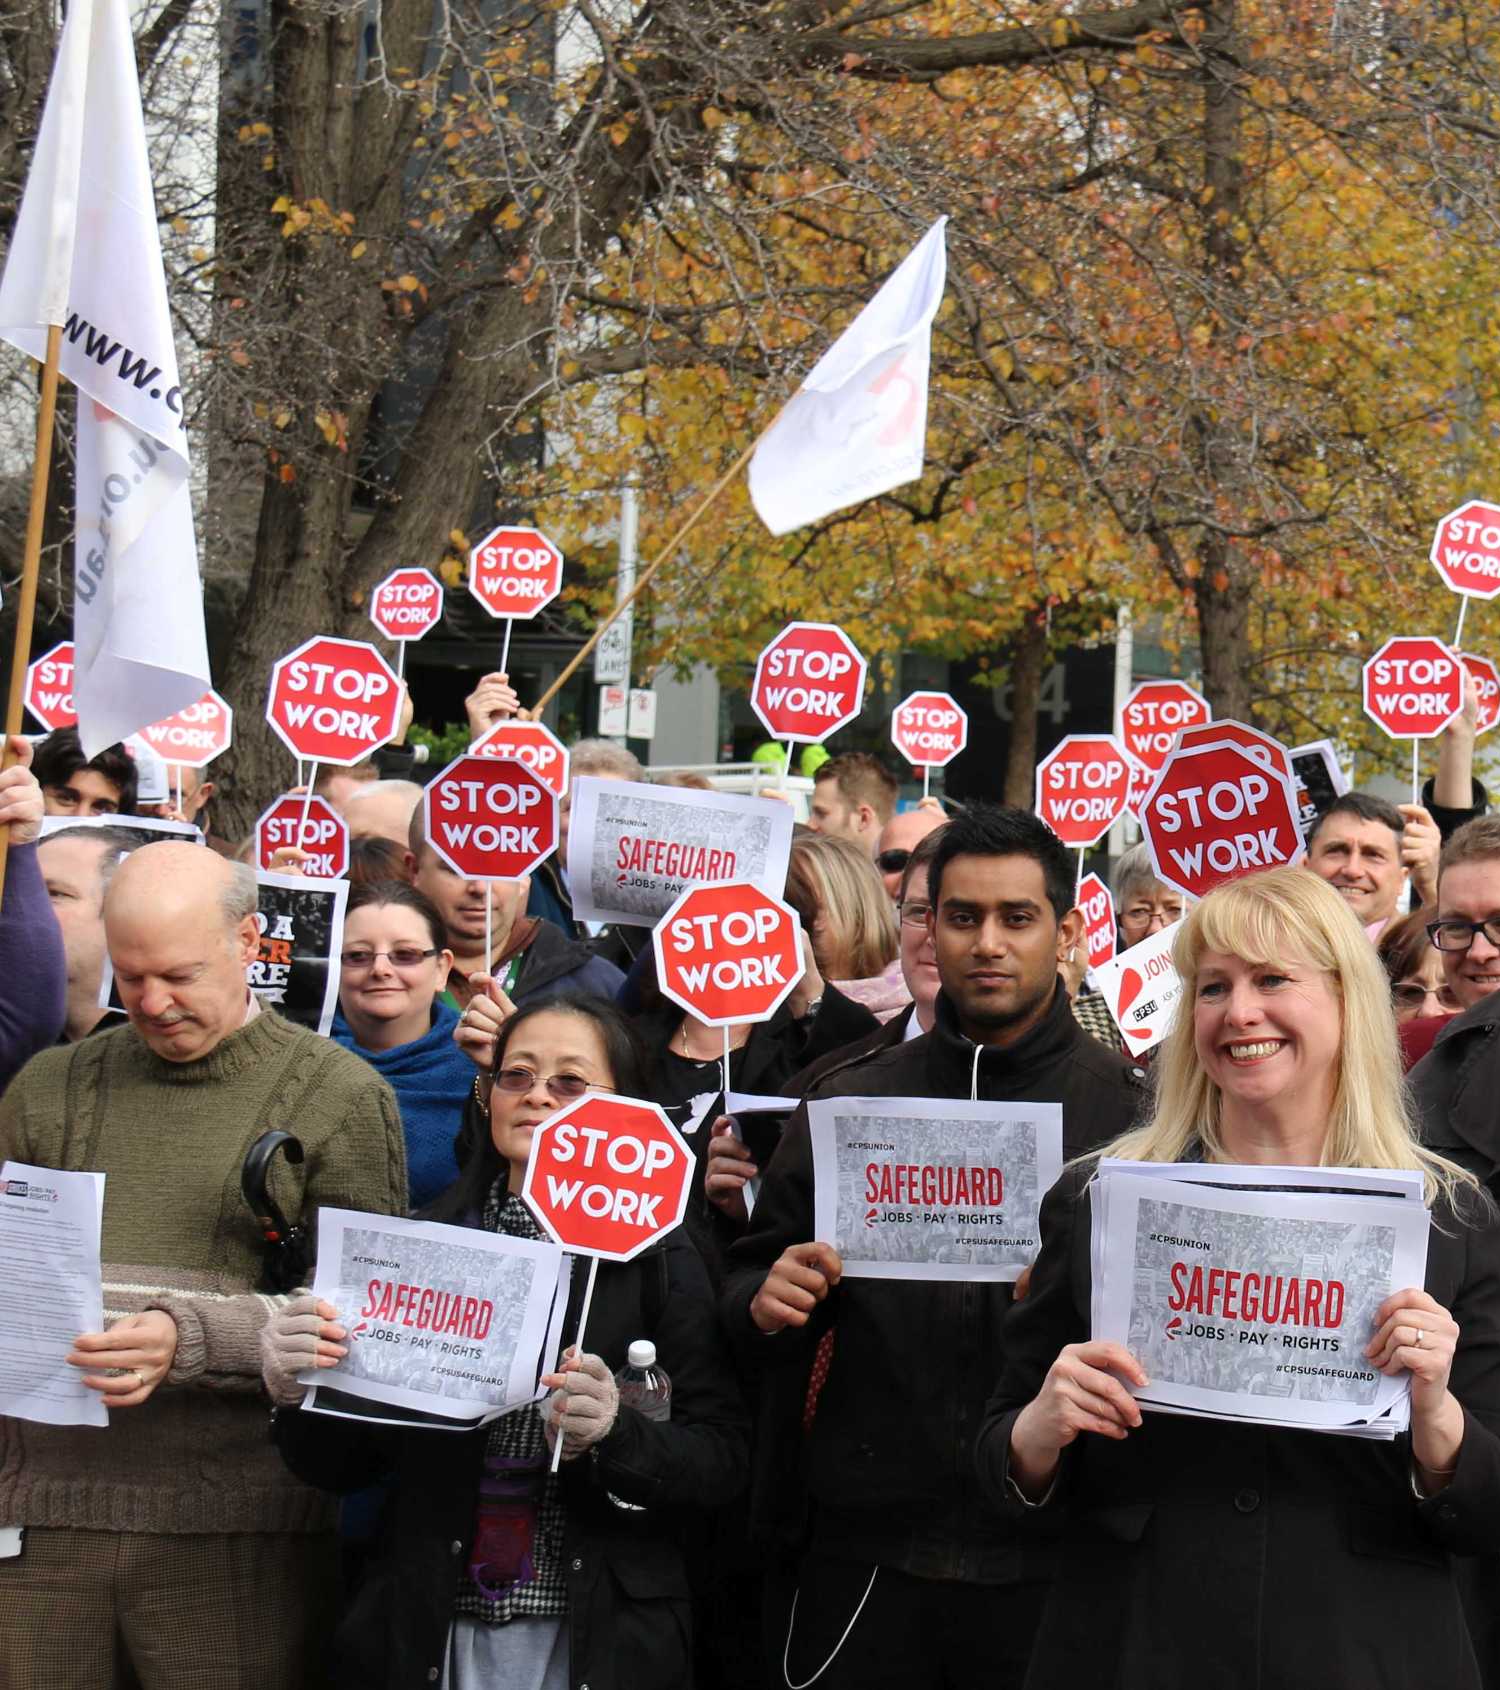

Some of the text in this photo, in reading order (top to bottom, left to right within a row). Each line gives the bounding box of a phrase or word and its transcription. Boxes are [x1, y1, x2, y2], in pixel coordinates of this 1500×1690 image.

[482, 548, 551, 571] STOP
[382, 585, 434, 604] STOP
[482, 577, 547, 599] WORK
[381, 607, 431, 625] WORK
[40, 661, 74, 686] ST
[768, 648, 852, 681] STOP
[1375, 658, 1453, 686] STOP
[287, 660, 389, 703] STOP
[1472, 676, 1498, 699] OP
[36, 690, 76, 715] WO
[765, 686, 846, 718] WORK
[1128, 701, 1199, 726] STOP
[1375, 693, 1451, 716] WORK
[285, 701, 381, 742] WORK
[902, 708, 958, 729] STOP
[147, 724, 217, 749] WORK
[902, 731, 956, 751] WORK
[1131, 733, 1177, 753] WO
[1048, 760, 1124, 790] STOP
[1131, 766, 1157, 784] ST
[440, 780, 542, 815] STOP
[1155, 774, 1270, 833] STOP
[1049, 798, 1118, 823] WORK
[267, 818, 337, 846] STOP
[441, 823, 541, 855] WORK
[616, 836, 737, 881] SAFEGUARD
[1169, 827, 1288, 881] WORK
[630, 877, 685, 894] JOBS PAY
[1082, 891, 1107, 926] TOP
[671, 908, 780, 953] STOP
[676, 954, 787, 994] WORK
[1144, 950, 1173, 981] JOIN
[1133, 1000, 1158, 1022] CPSU
[551, 1123, 675, 1178] STOP
[848, 1142, 895, 1151] #CPSUNION
[865, 1162, 1003, 1206] SAFEGUARD
[546, 1174, 665, 1230] WORK
[881, 1212, 1003, 1225] JOBS PAY RIGHTS
[955, 1237, 1034, 1246] #CPSUSAFEGUARD
[1149, 1233, 1211, 1251] #CPSUNION
[352, 1256, 400, 1269] #CPSUNION
[1168, 1261, 1345, 1330] SAFEGUARD
[361, 1279, 494, 1341] SAFEGUARD
[368, 1327, 482, 1359] JOBS PAY RIGHTS
[1185, 1323, 1339, 1352] JOBS PAY RIGHTS
[430, 1366, 504, 1386] #CPSUSAFEGUARD
[1275, 1364, 1375, 1382] #CPSUSAFEGUARD
